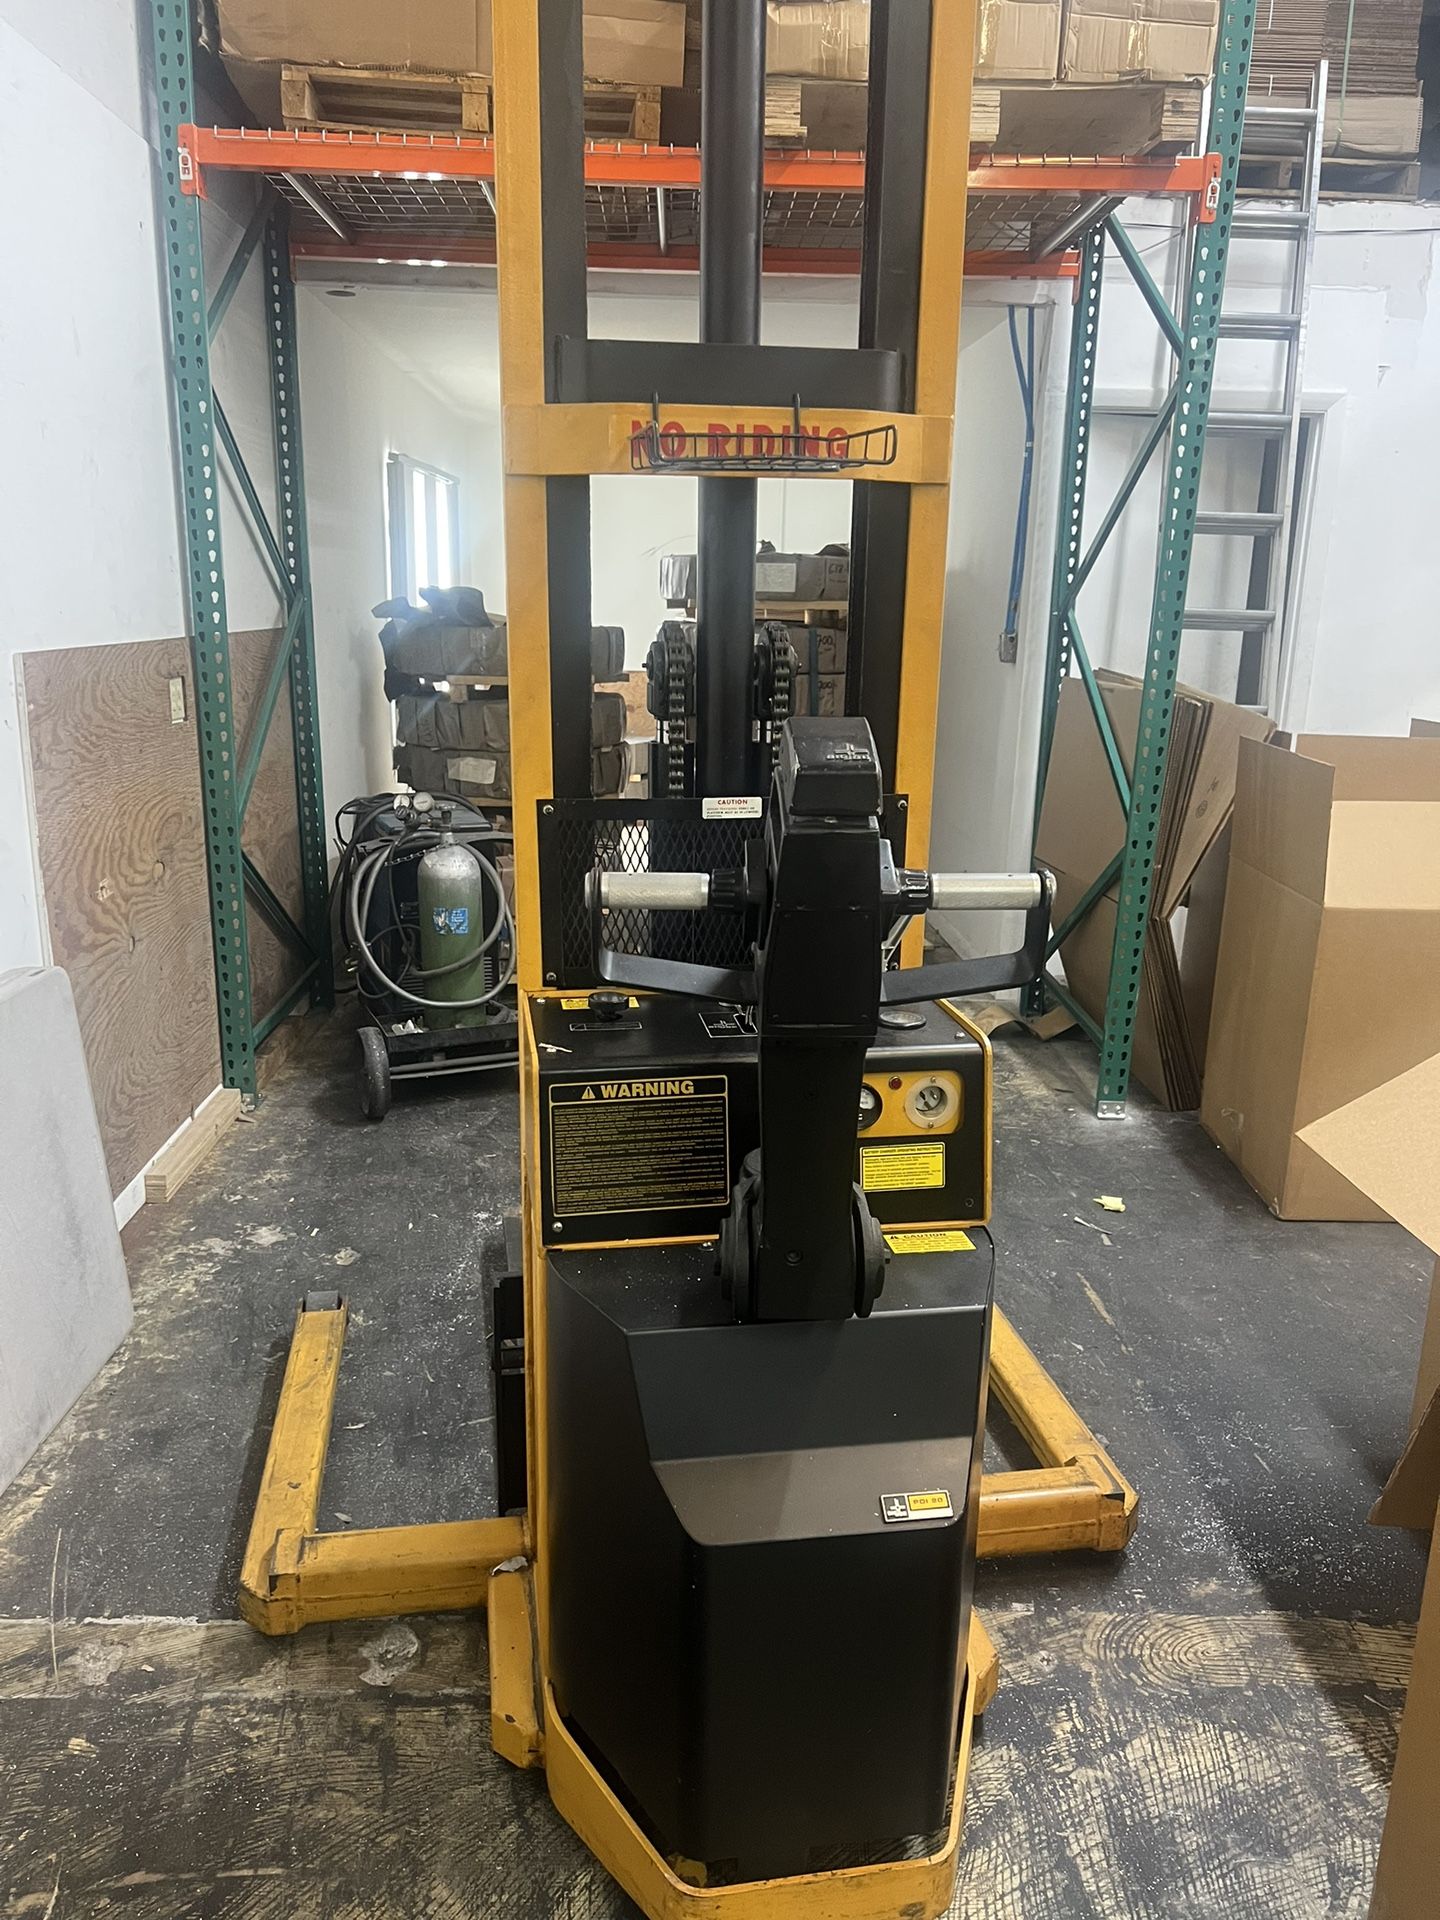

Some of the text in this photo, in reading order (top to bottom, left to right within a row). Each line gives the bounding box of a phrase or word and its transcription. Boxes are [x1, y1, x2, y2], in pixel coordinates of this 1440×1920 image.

[631, 419, 849, 460] NO RIDING
[600, 1080, 695, 1098] WARNING
